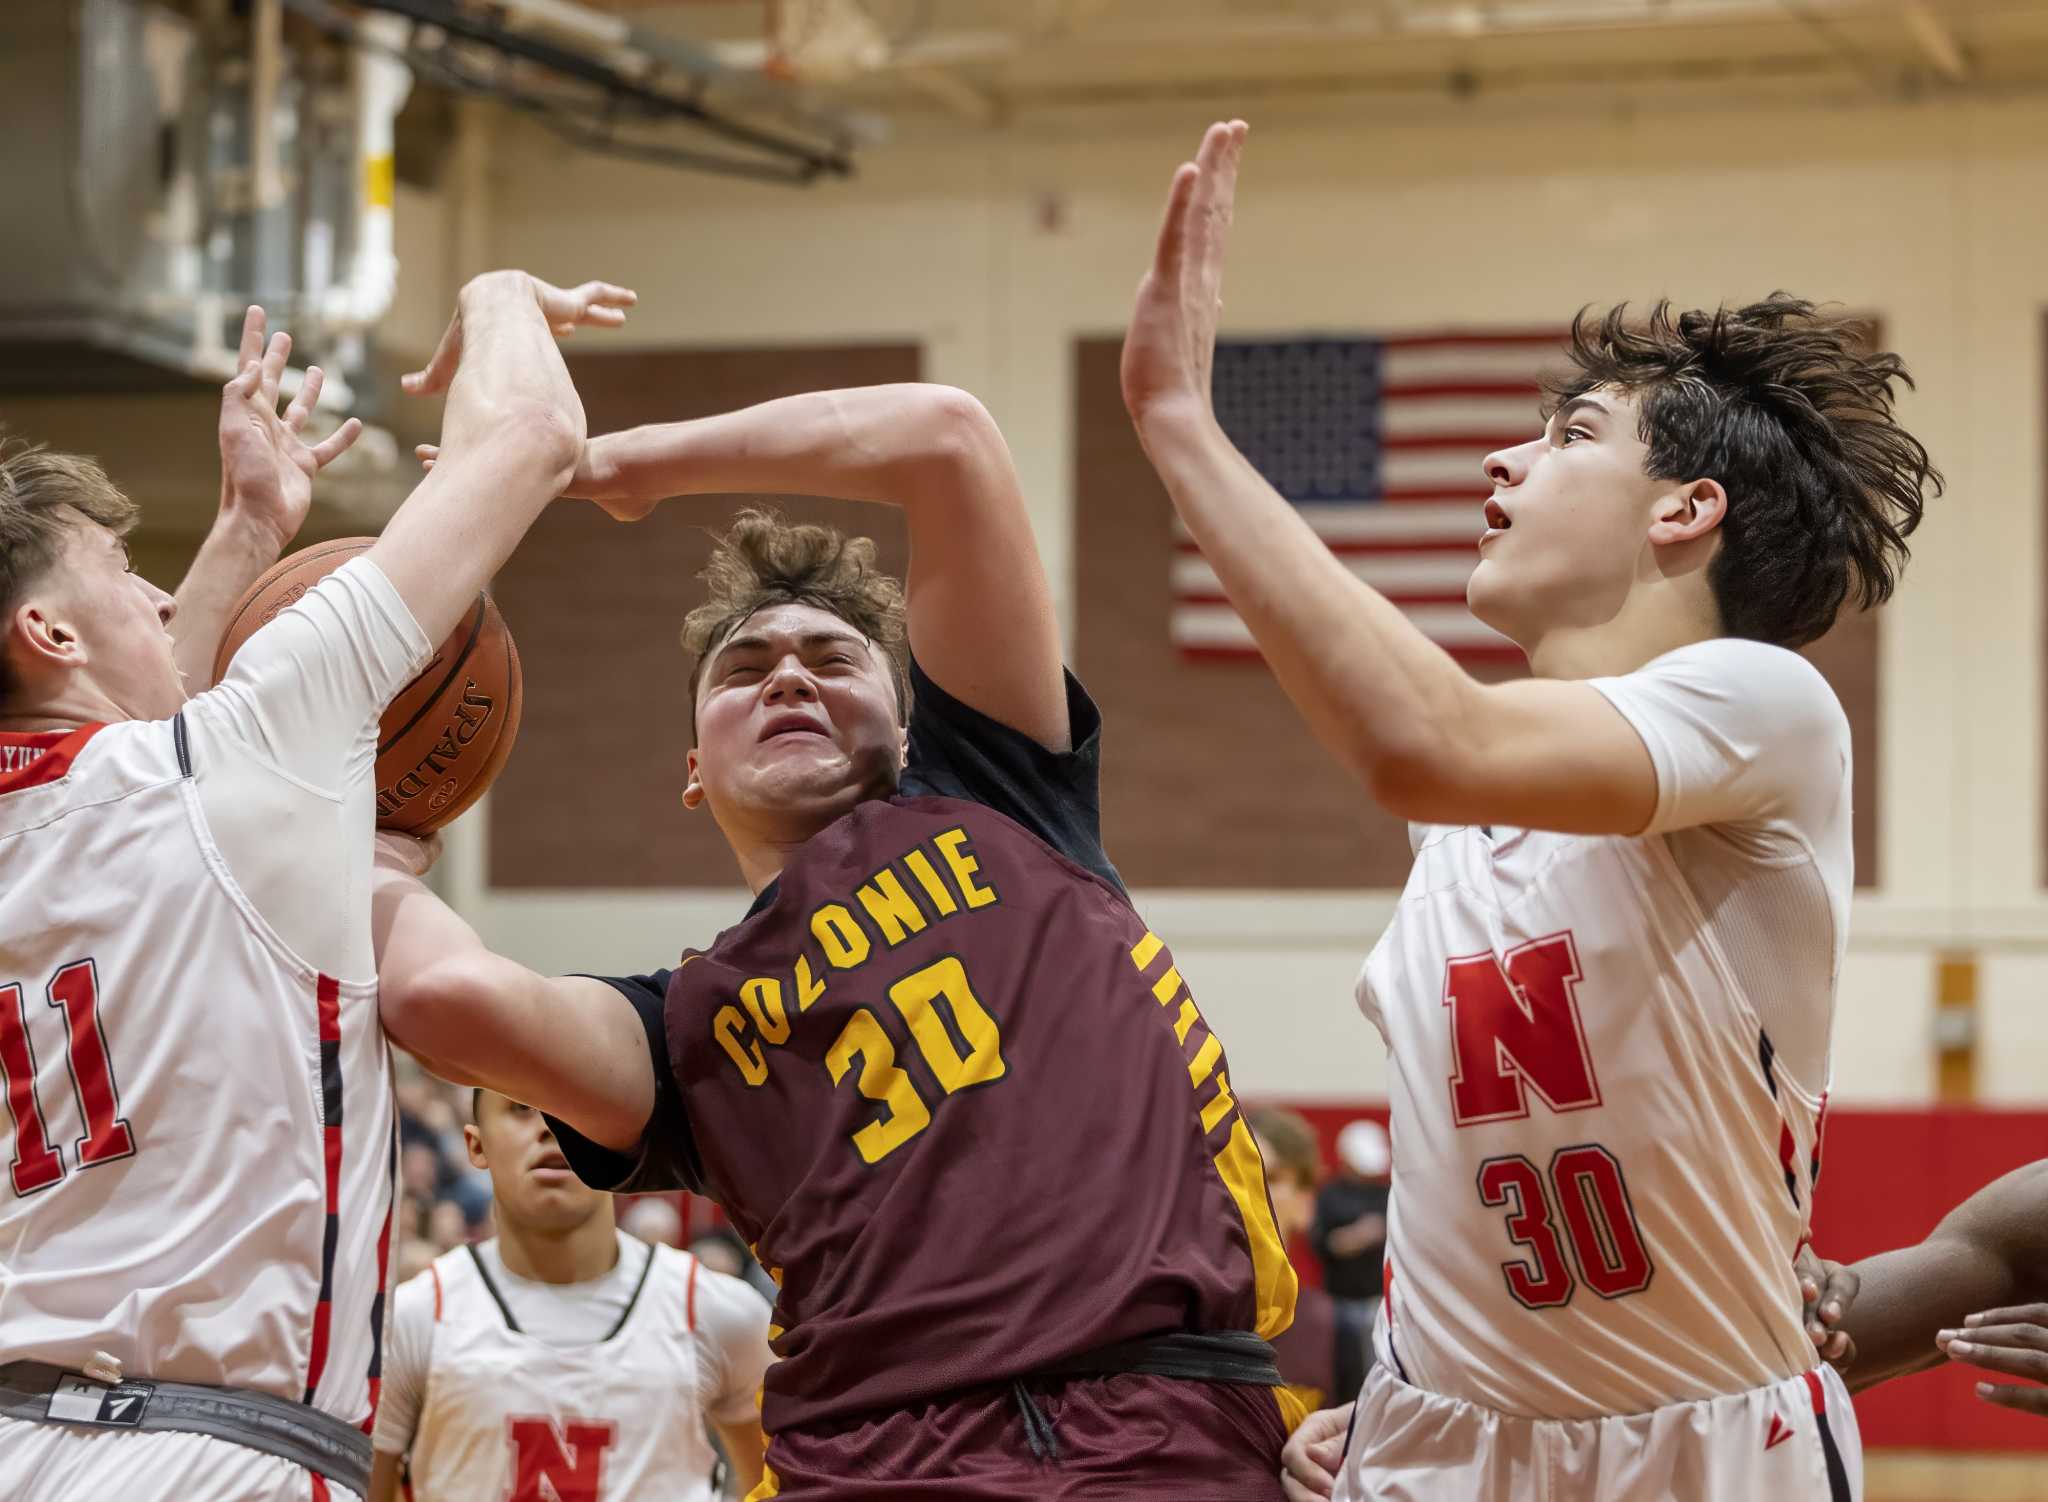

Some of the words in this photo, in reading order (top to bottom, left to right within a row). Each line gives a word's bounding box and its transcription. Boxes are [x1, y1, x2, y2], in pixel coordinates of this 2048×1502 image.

[711, 826, 999, 1088] COLONIE
[1442, 929, 1603, 1128] N
[0, 957, 136, 1198] 11
[823, 955, 1008, 1165] 30
[1476, 1144, 1655, 1310] 30
[506, 1414, 619, 1502] N
